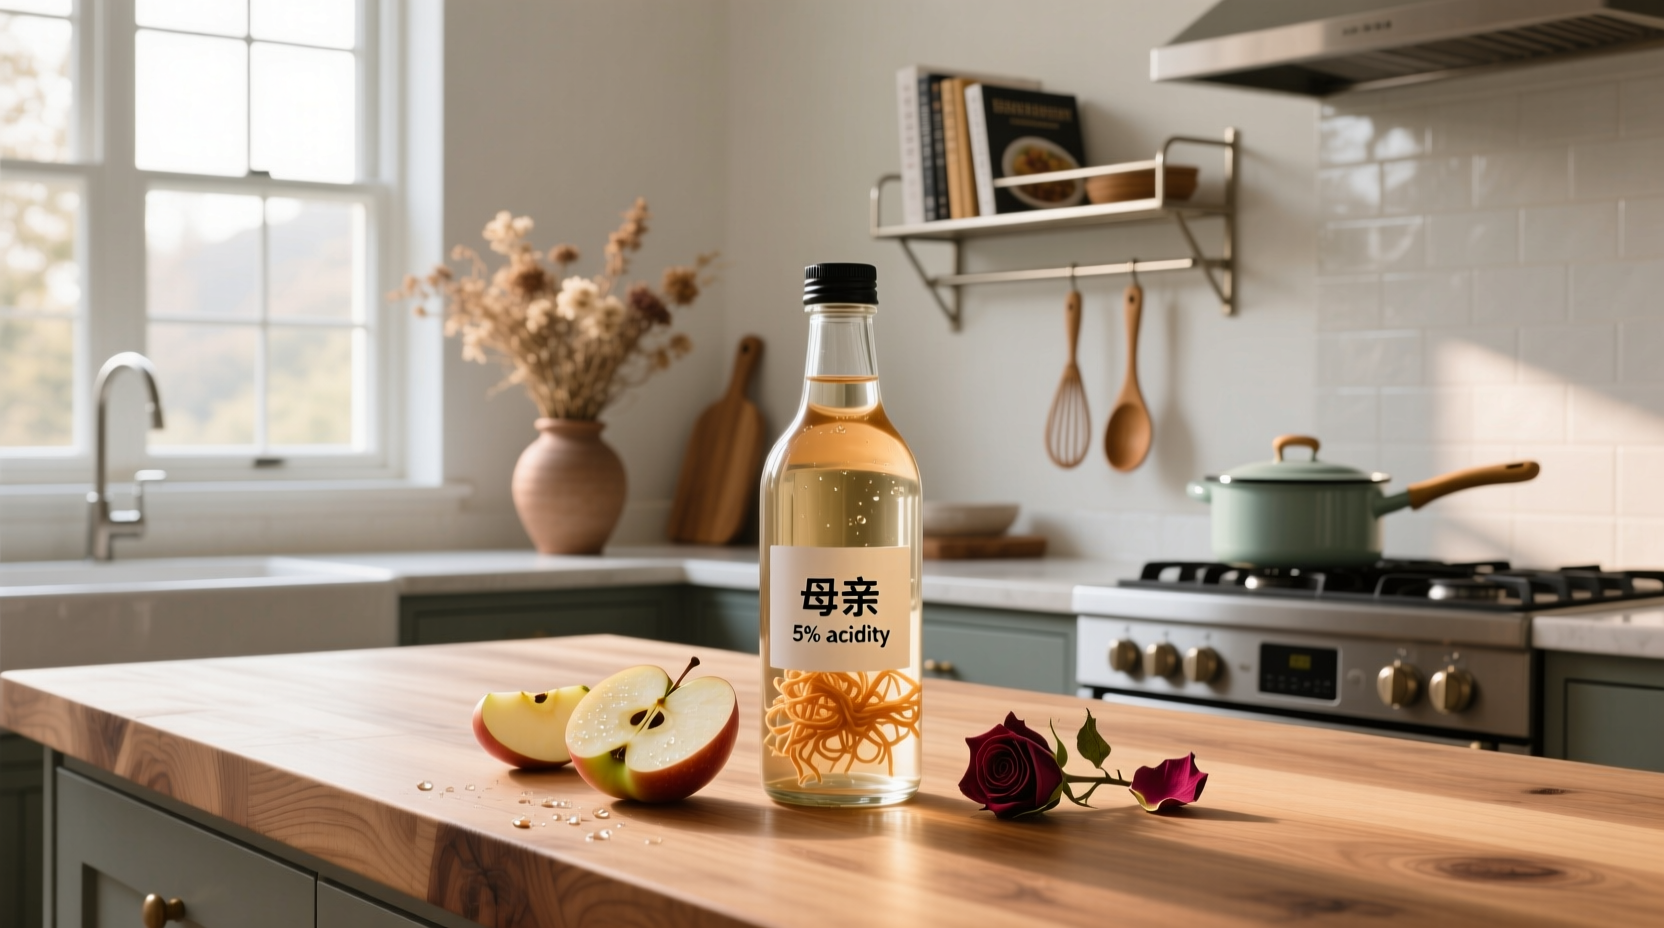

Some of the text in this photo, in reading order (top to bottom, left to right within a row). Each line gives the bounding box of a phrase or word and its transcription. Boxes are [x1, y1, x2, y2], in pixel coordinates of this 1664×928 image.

[800, 576, 879, 617] 母亲
[792, 624, 891, 648] 5% acidity
